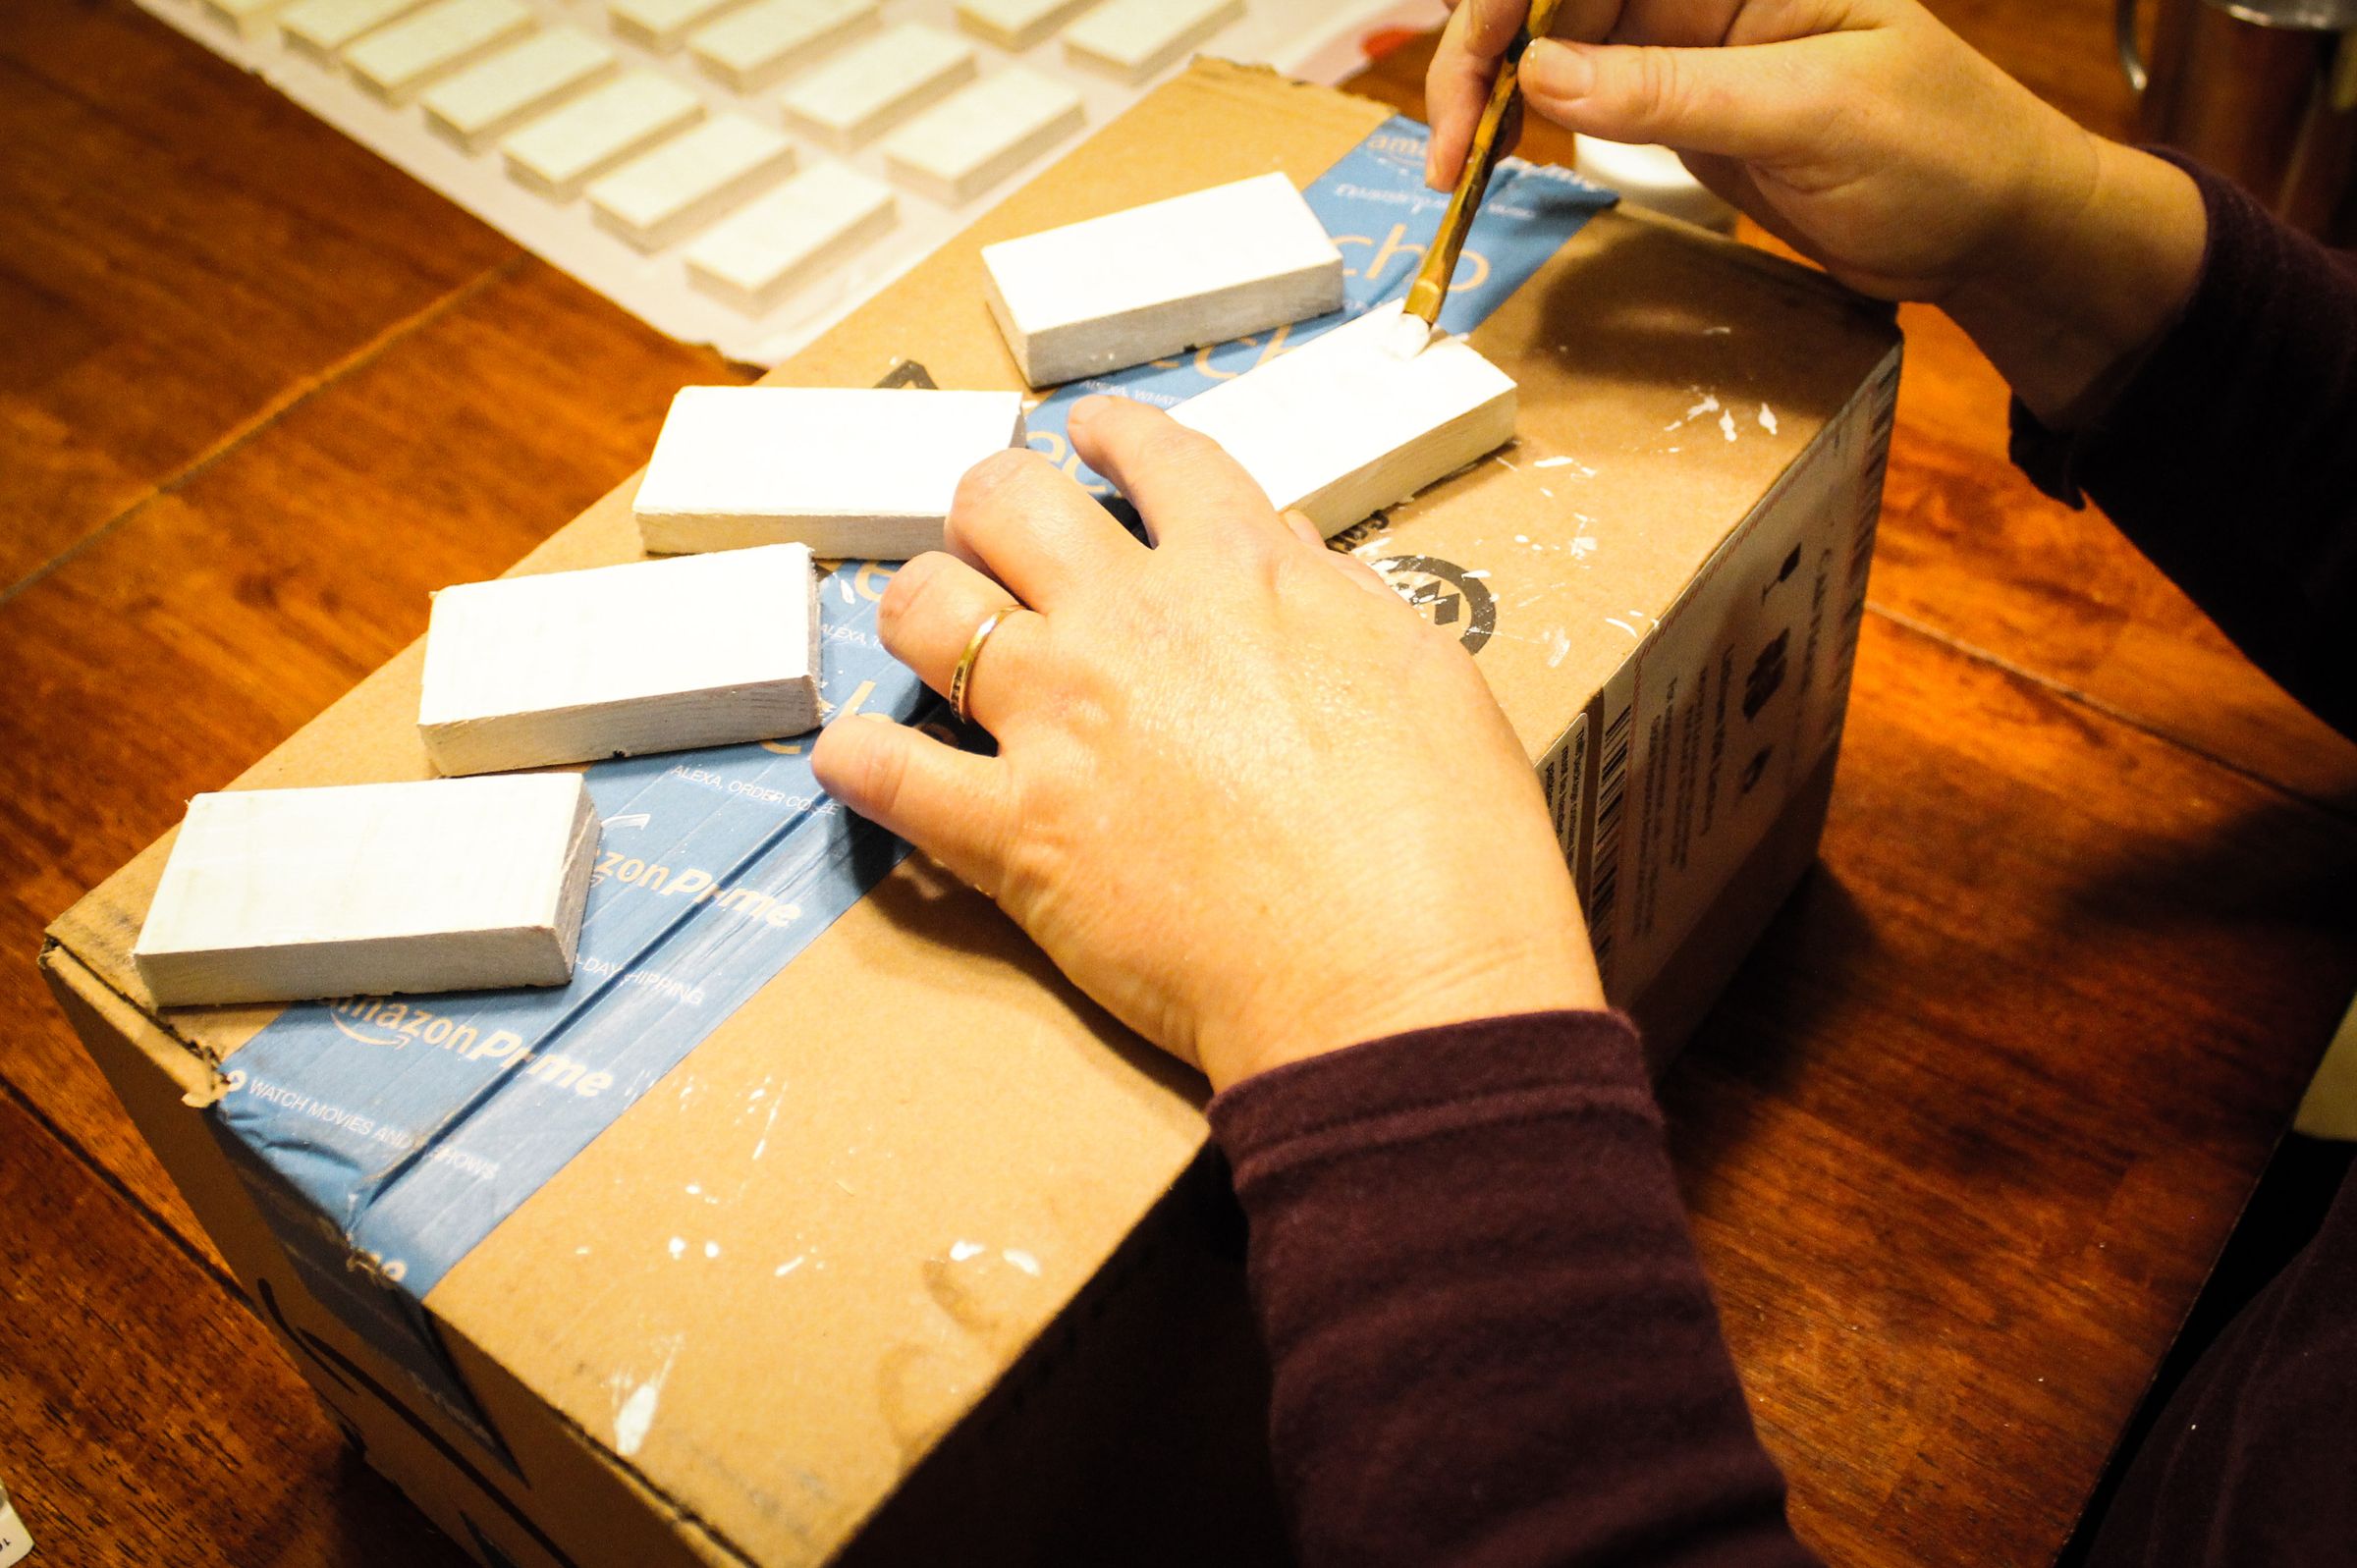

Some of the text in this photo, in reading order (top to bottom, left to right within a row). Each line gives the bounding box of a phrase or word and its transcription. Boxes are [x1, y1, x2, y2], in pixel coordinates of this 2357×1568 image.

[670, 764, 724, 790] ALEXA,
[728, 780, 786, 803] ORDER
[624, 970, 705, 1005] HIPPING
[248, 1079, 309, 1111] WATCH
[308, 1101, 375, 1136] MOVIES
